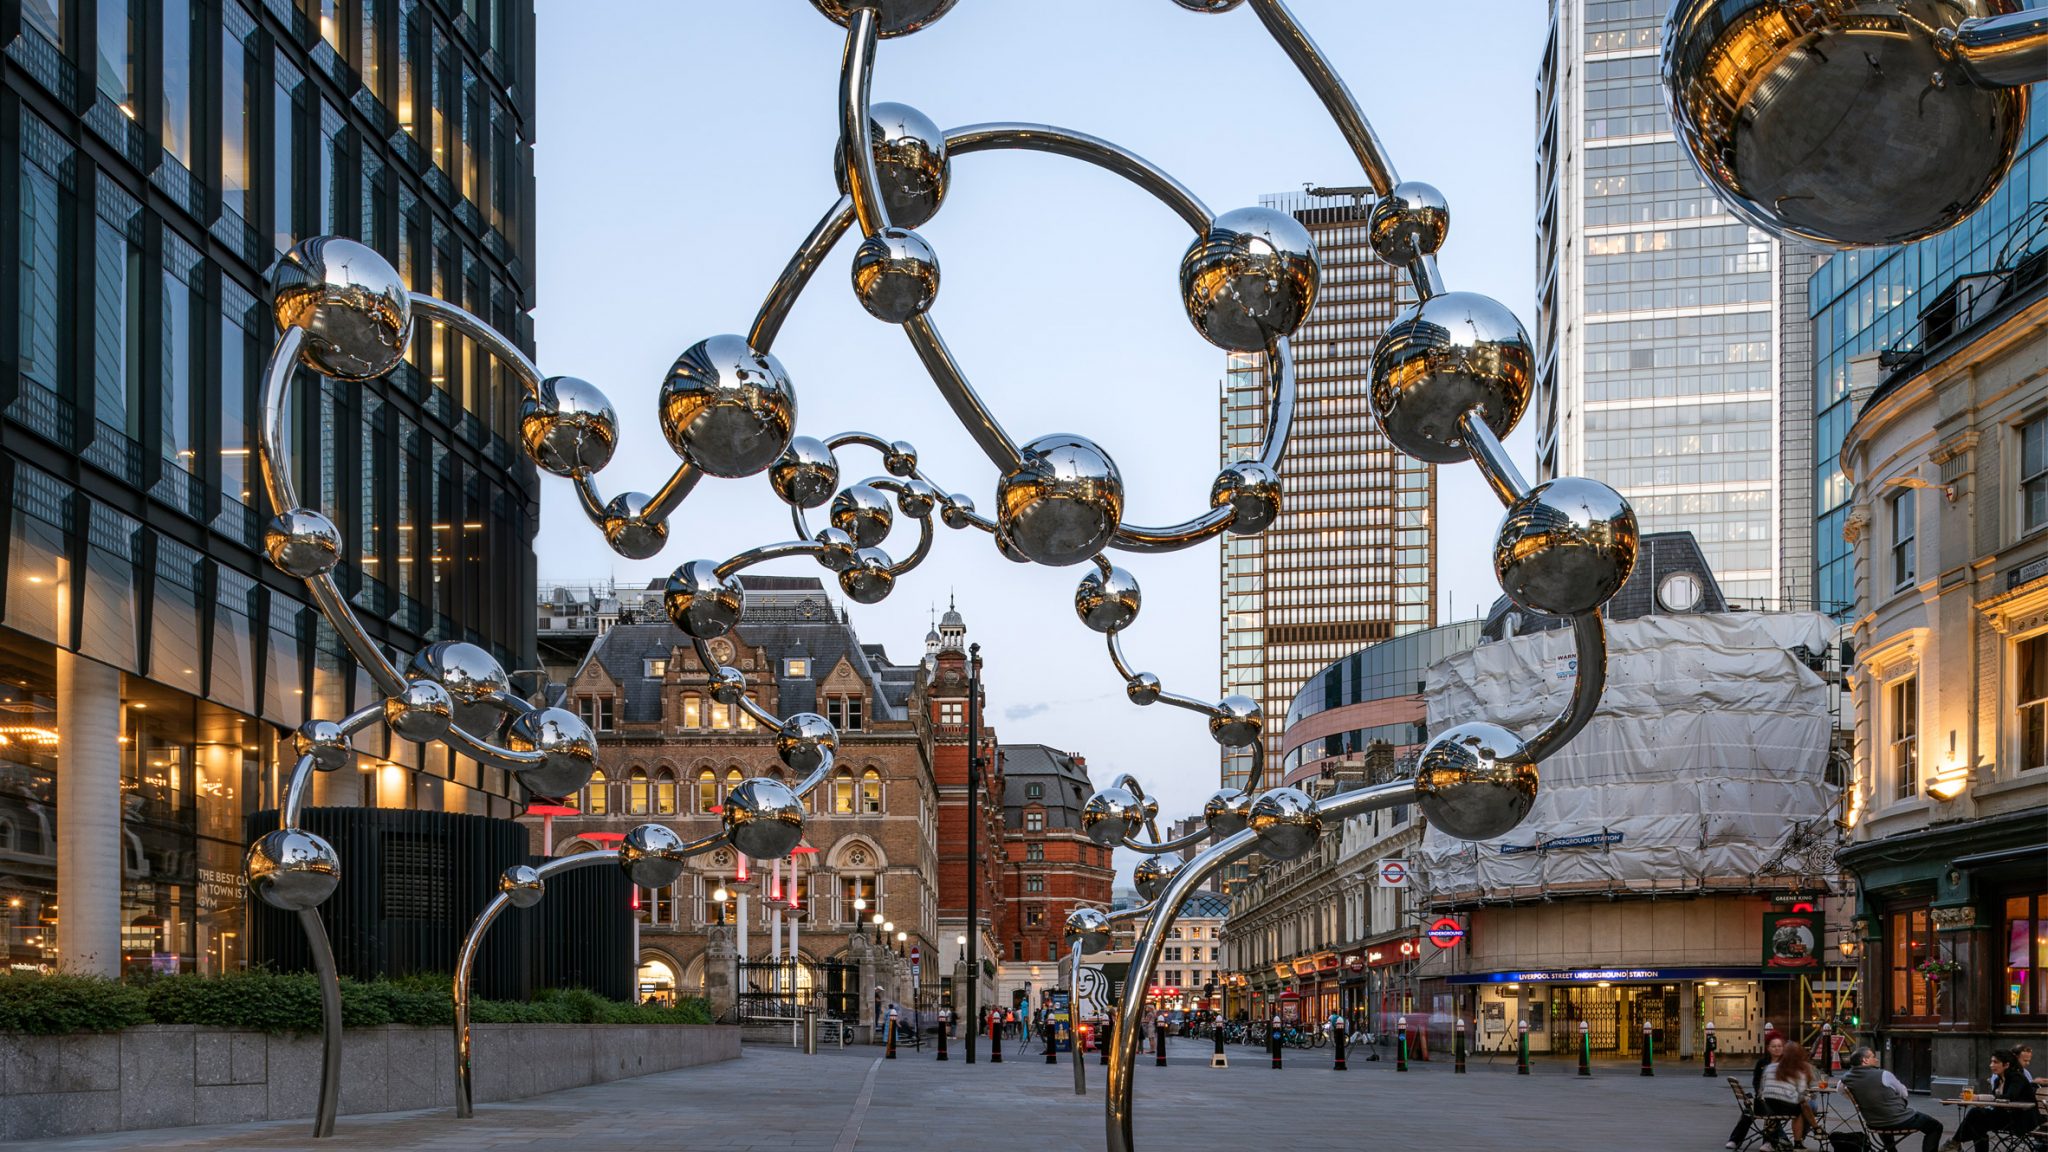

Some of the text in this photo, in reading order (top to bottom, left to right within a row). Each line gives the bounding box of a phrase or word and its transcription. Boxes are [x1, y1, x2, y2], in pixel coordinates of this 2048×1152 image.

[1593, 834, 1620, 842] STATION
[198, 868, 214, 882] THE
[216, 871, 235, 885] BEST
[198, 882, 208, 894] IN
[209, 883, 233, 898] TOWN
[235, 887, 242, 899] IS
[199, 896, 217, 909] GYM
[1574, 971, 1627, 979] UNDERGROUND
[1629, 970, 1658, 978] STATION
